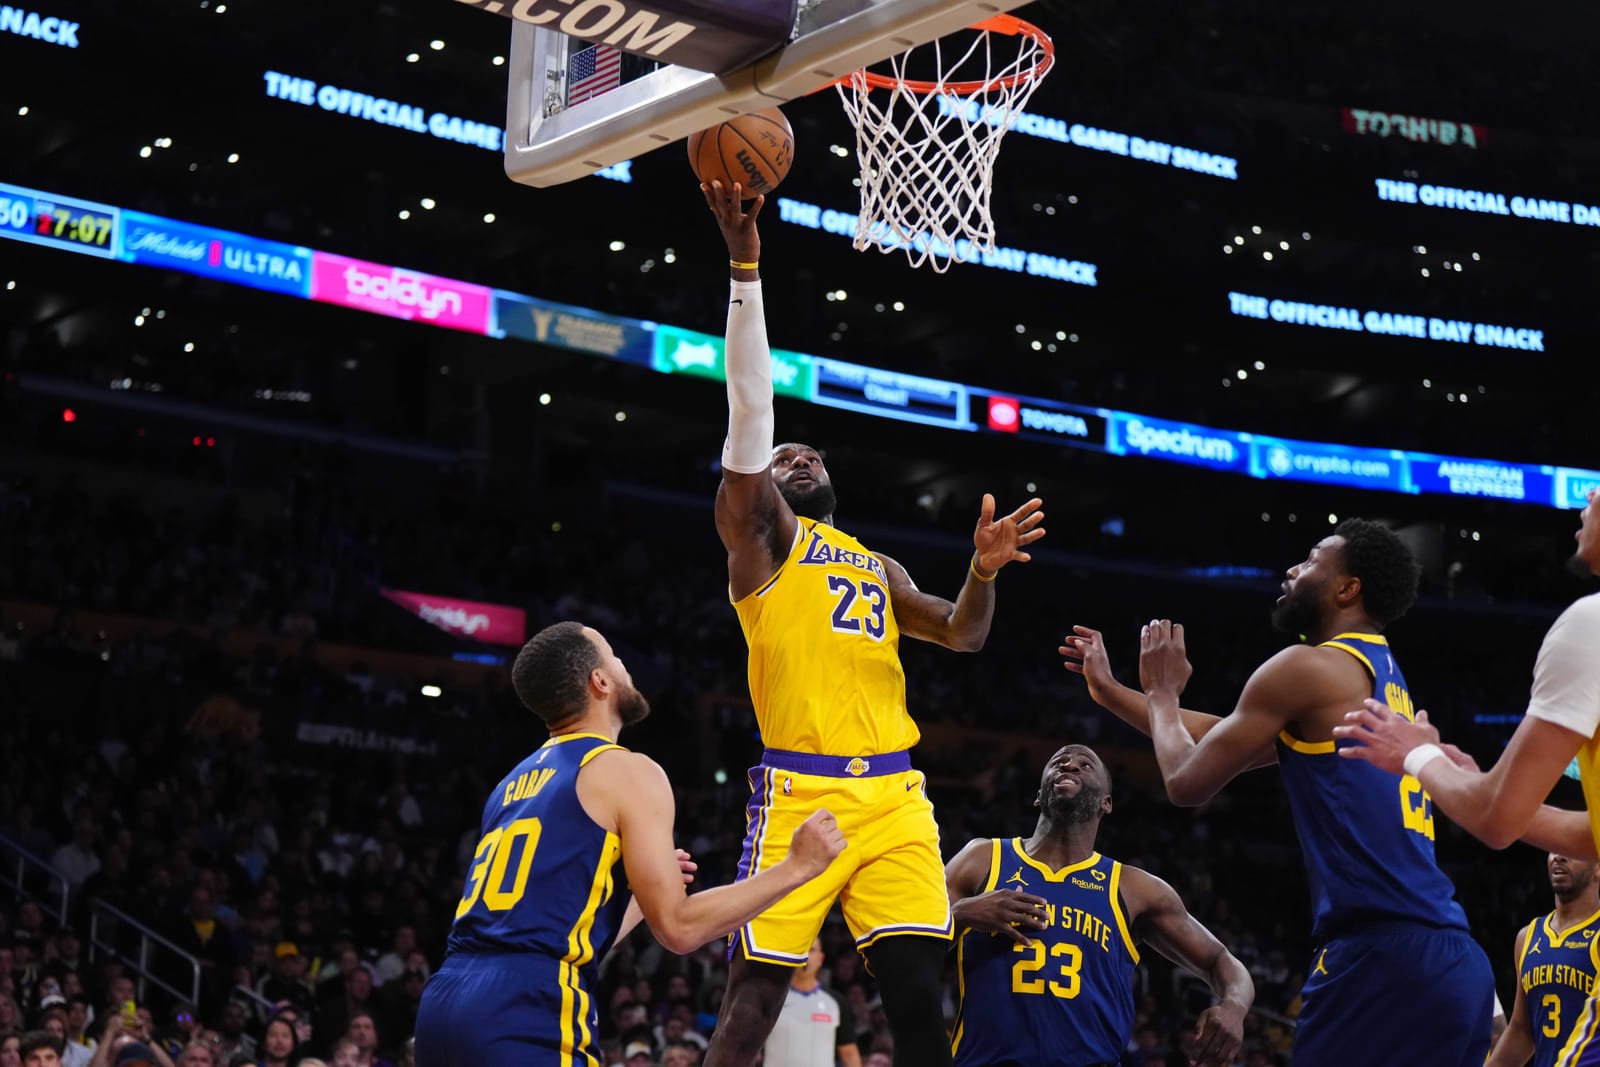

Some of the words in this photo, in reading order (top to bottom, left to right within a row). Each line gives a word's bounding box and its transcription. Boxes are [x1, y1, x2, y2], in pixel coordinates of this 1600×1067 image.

[0, 4, 80, 48] NACK
[453, 0, 697, 56] .COM
[264, 70, 316, 106] THE
[316, 85, 428, 134] OFFICIAL
[428, 112, 501, 152] GAME
[1351, 109, 1477, 149] TOSHIBA
[1069, 123, 1129, 156] GAME
[1129, 136, 1172, 165] DAY
[1170, 146, 1238, 180] SNACK
[1375, 178, 1418, 203] THE
[1418, 184, 1510, 216] OFFICIAL
[1510, 196, 1571, 223] GAME
[53, 208, 112, 246] 7:07
[777, 197, 822, 229] THE
[1026, 252, 1098, 287] SNACK
[224, 246, 302, 283] ULTRA
[344, 265, 462, 318] boldyn
[1228, 291, 1269, 320] THE
[1269, 299, 1363, 332] OFFICIAL
[1363, 311, 1427, 339] GAME
[1428, 317, 1473, 343] DAY
[1473, 323, 1545, 352] SNACK
[1020, 408, 1088, 437] TOYOTA
[1126, 418, 1234, 463] Spectrum
[1293, 453, 1390, 478] crypto.com
[1437, 460, 1524, 483] AMERICAN
[1449, 477, 1526, 500] EXPRESS
[826, 573, 888, 642] 23
[455, 816, 543, 919] 30
[1061, 905, 1112, 953] STATE
[1012, 938, 1083, 1000] 23
[1555, 963, 1595, 999] STATE
[1542, 993, 1562, 1039] 3
